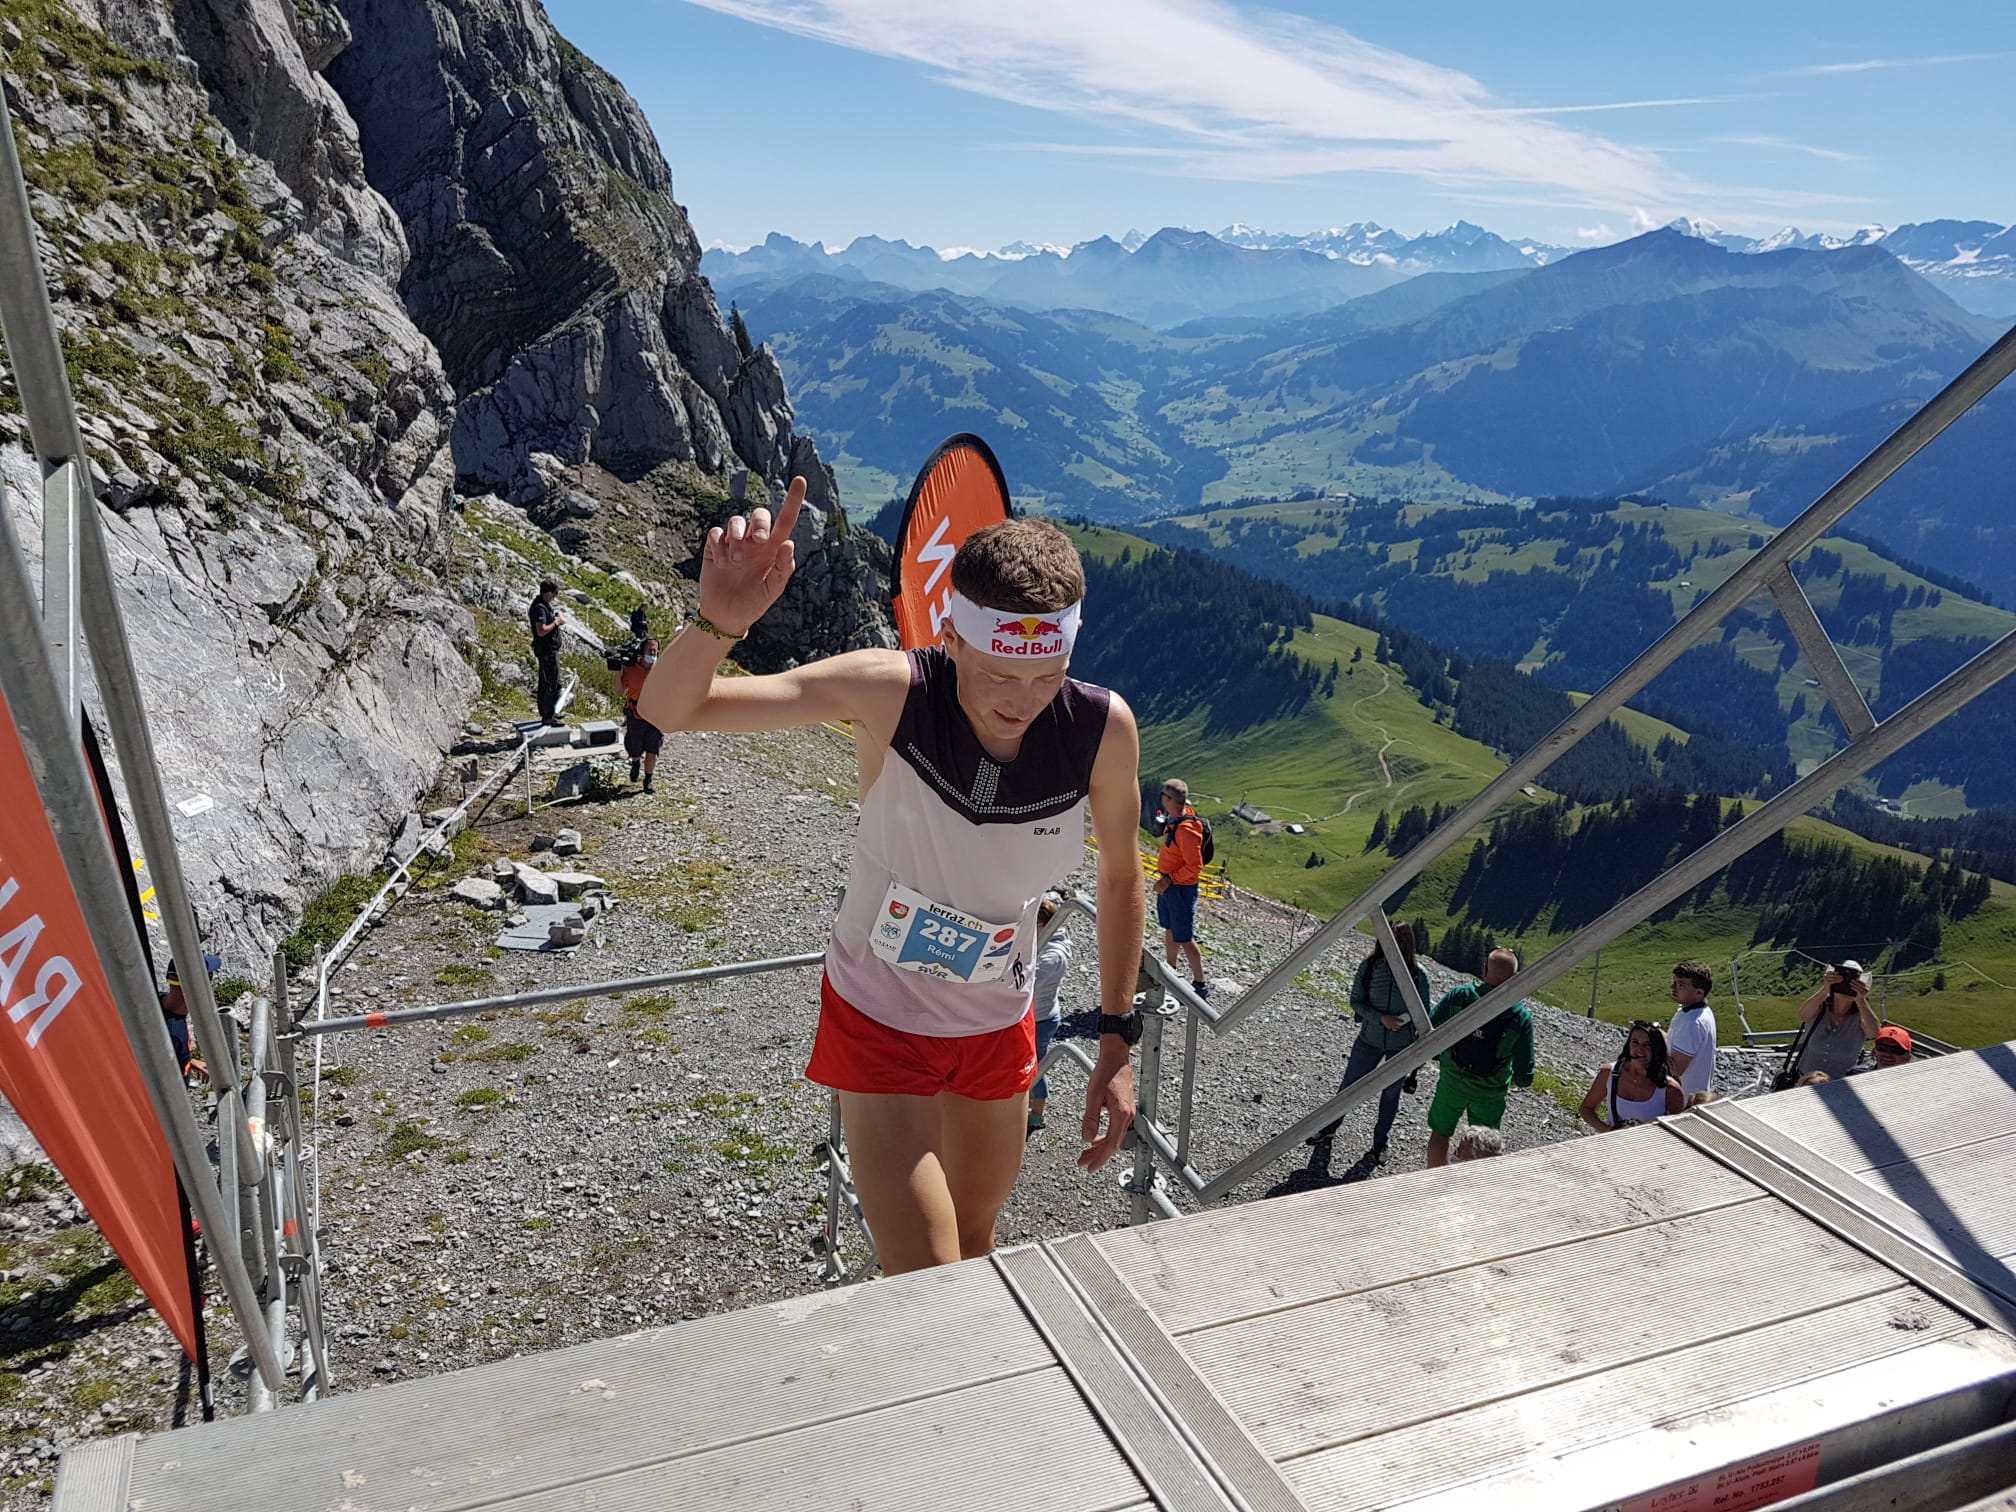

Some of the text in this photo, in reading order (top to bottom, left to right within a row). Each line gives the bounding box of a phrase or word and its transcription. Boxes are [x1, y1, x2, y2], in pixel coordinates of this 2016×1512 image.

[992, 638, 1063, 655] Red Bull
[929, 903, 983, 931] terraz.ch
[919, 918, 977, 952] 287
